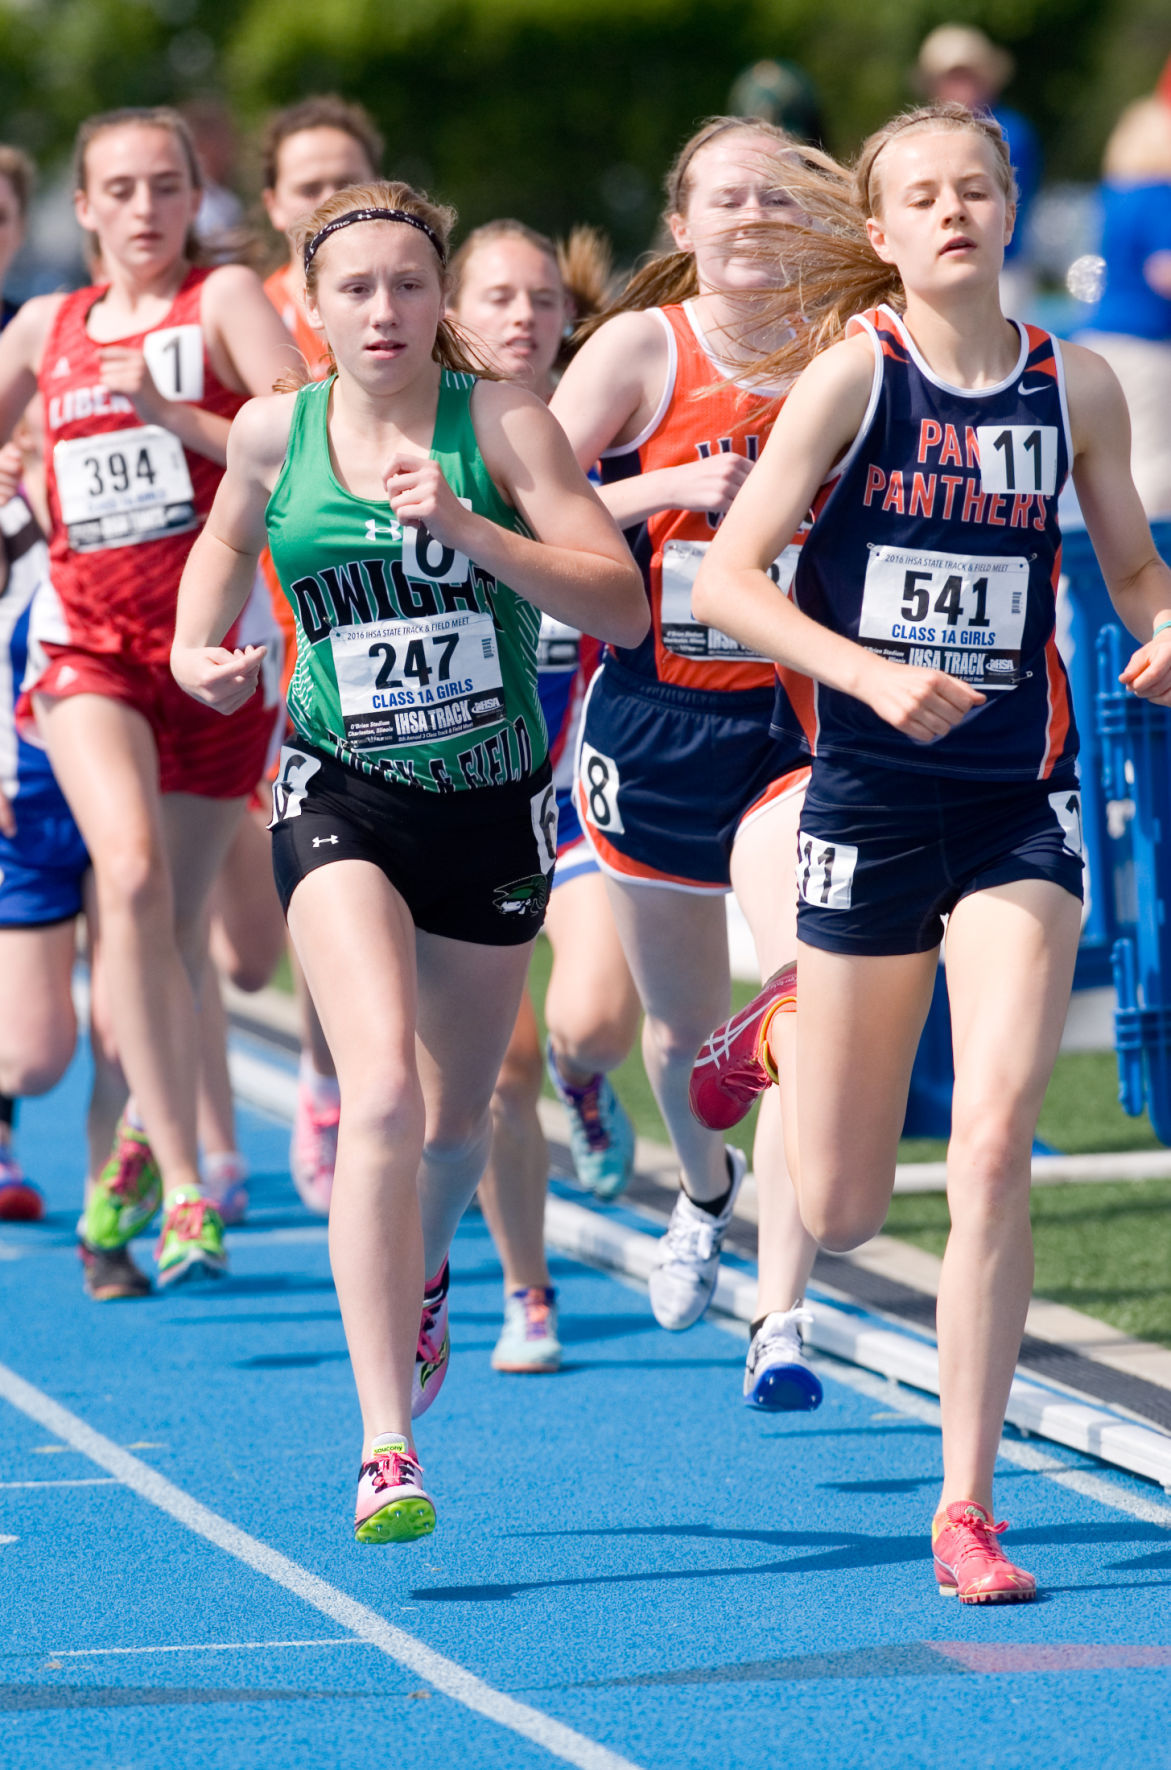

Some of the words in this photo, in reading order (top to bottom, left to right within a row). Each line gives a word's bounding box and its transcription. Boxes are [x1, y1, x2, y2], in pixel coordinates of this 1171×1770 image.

[162, 337, 183, 394] 1
[84, 447, 156, 497] 394
[993, 429, 1042, 491] 11
[863, 463, 1048, 531] PANTHERS
[415, 521, 456, 578] 6
[885, 554, 904, 563] 2016
[905, 557, 923, 566] IHSA
[923, 559, 943, 569] STATE
[944, 561, 967, 572] TRACK
[968, 563, 974, 572] &
[974, 563, 992, 573] FIELD
[991, 564, 1009, 573] MEET
[290, 559, 505, 646] DWIGHT
[900, 569, 990, 628] 541
[347, 632, 365, 641] 2016
[366, 631, 382, 639] IHSA
[382, 628, 401, 638] STATE
[403, 625, 423, 635] TRACK
[425, 624, 430, 633] &
[431, 620, 451, 631] FIELD
[451, 616, 470, 628] MEET
[891, 623, 936, 642] CLASS
[941, 629, 957, 644] 1A
[960, 630, 996, 646] GIRLS
[368, 632, 460, 690] 247
[908, 647, 941, 671] IHSA
[944, 651, 986, 675] TRACK
[372, 691, 415, 709] CLASS
[417, 689, 434, 704] 1A
[436, 678, 474, 699] GIRLS
[394, 709, 428, 736] IHSA
[428, 700, 472, 730] TRACK
[370, 720, 390, 728] Stadium
[376, 726, 394, 734] Illinois
[457, 714, 532, 791] FIELD
[587, 756, 611, 826] 8
[802, 840, 836, 904] 11
[374, 1445, 403, 1453] saucony
